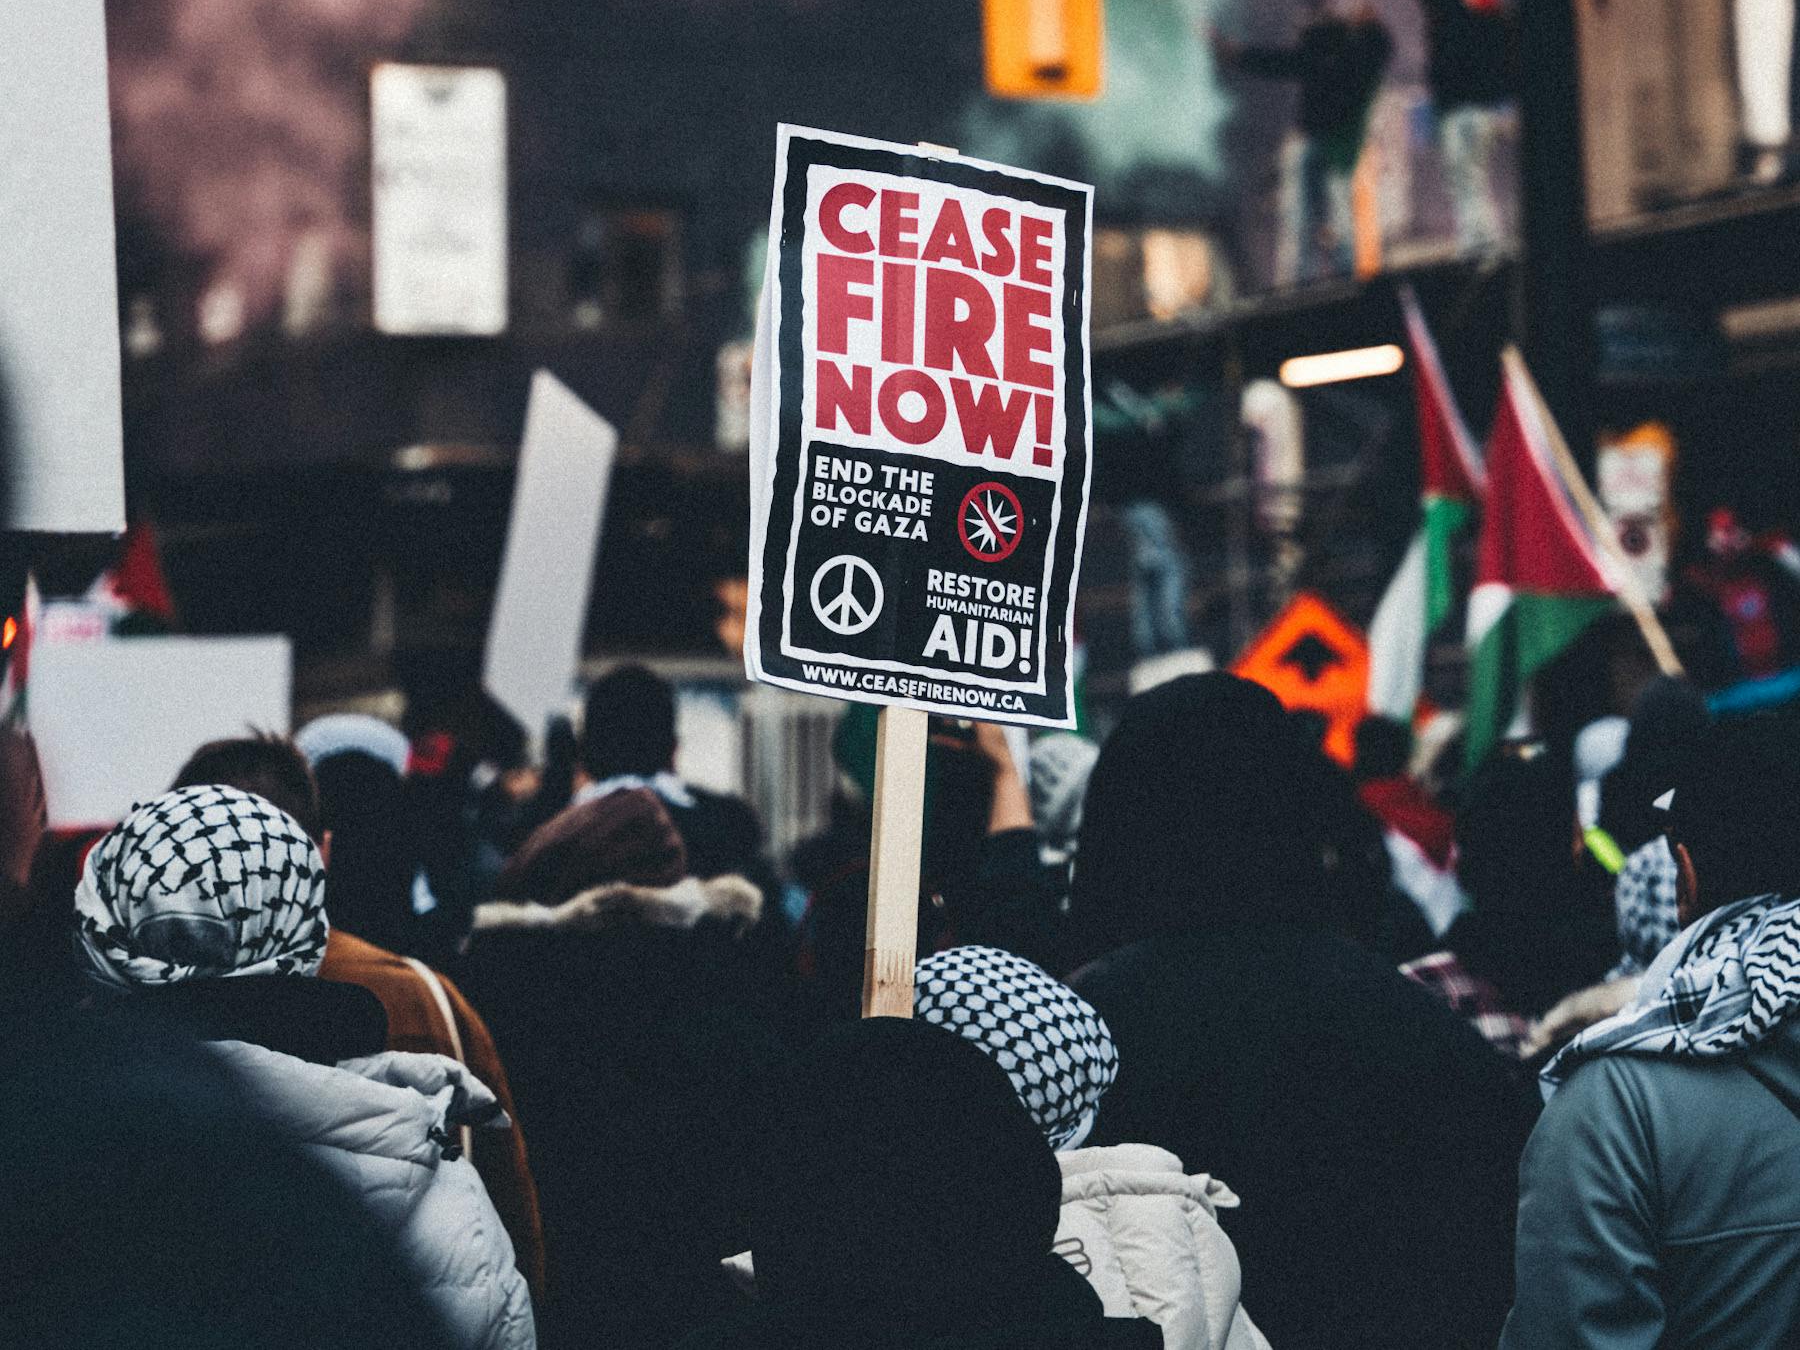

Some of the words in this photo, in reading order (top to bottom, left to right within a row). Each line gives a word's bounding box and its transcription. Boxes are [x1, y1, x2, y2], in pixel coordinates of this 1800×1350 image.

[818, 182, 1053, 288] CEASE
[816, 253, 1054, 391] FIRE
[814, 358, 1054, 468] NOW!
[814, 455, 873, 485] END
[881, 465, 934, 496] THE
[812, 482, 933, 517] BLOCKADE
[810, 505, 847, 528] OF
[854, 512, 929, 542] GAZA
[926, 568, 1036, 609] RESTORE
[926, 595, 1034, 626] HUMANITARIAN
[921, 614, 1033, 674] AID!
[802, 663, 1027, 711] WWW.CEASEFIRENOW.CA
